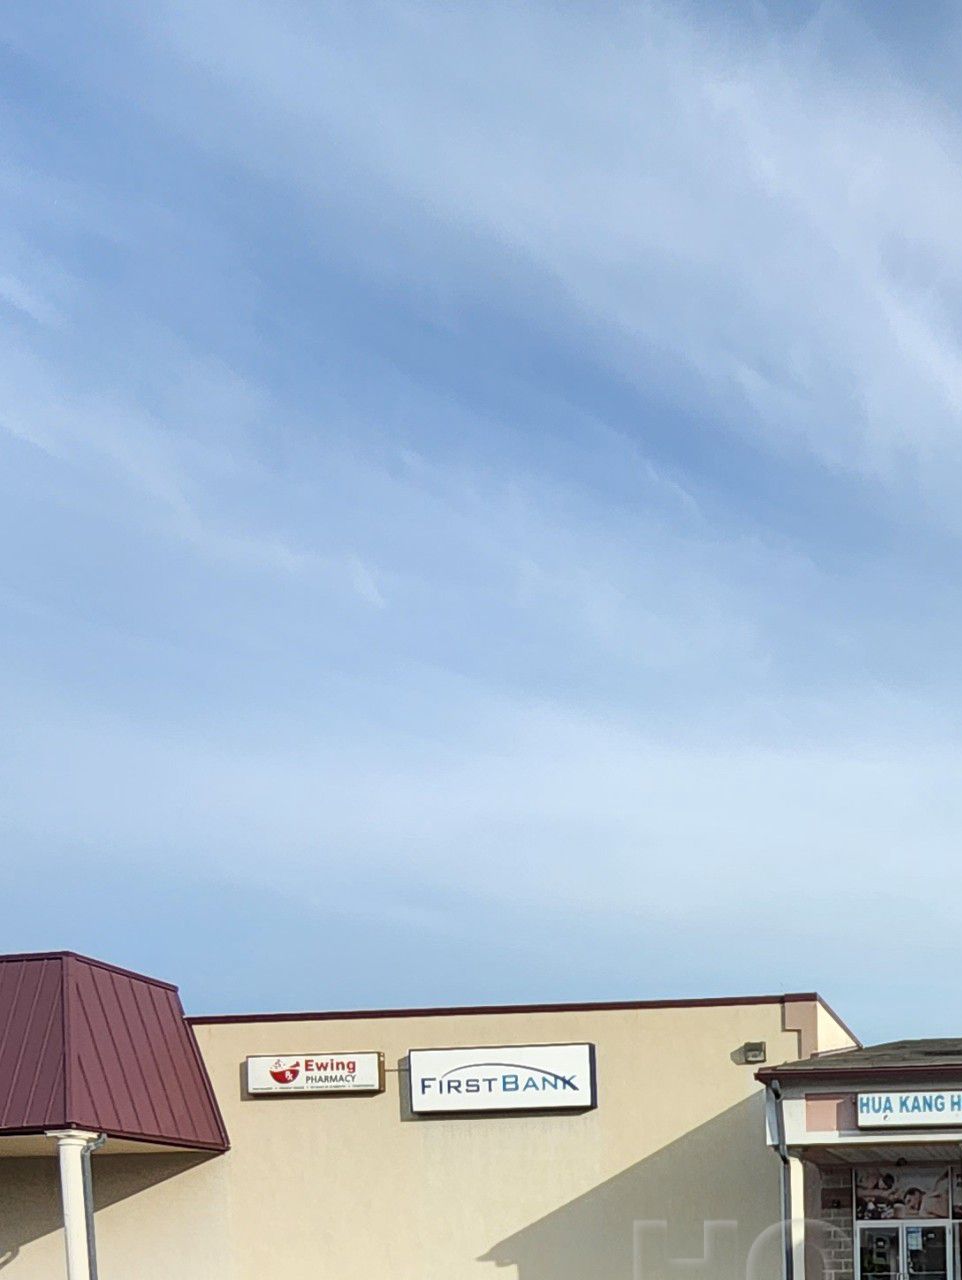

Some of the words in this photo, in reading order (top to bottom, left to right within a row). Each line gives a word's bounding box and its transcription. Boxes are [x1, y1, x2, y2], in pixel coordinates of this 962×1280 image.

[304, 1058, 356, 1074] Ewing
[305, 1074, 357, 1085] PHARMACY
[859, 1096, 894, 1115] HUA
[899, 1094, 946, 1113] KANG
